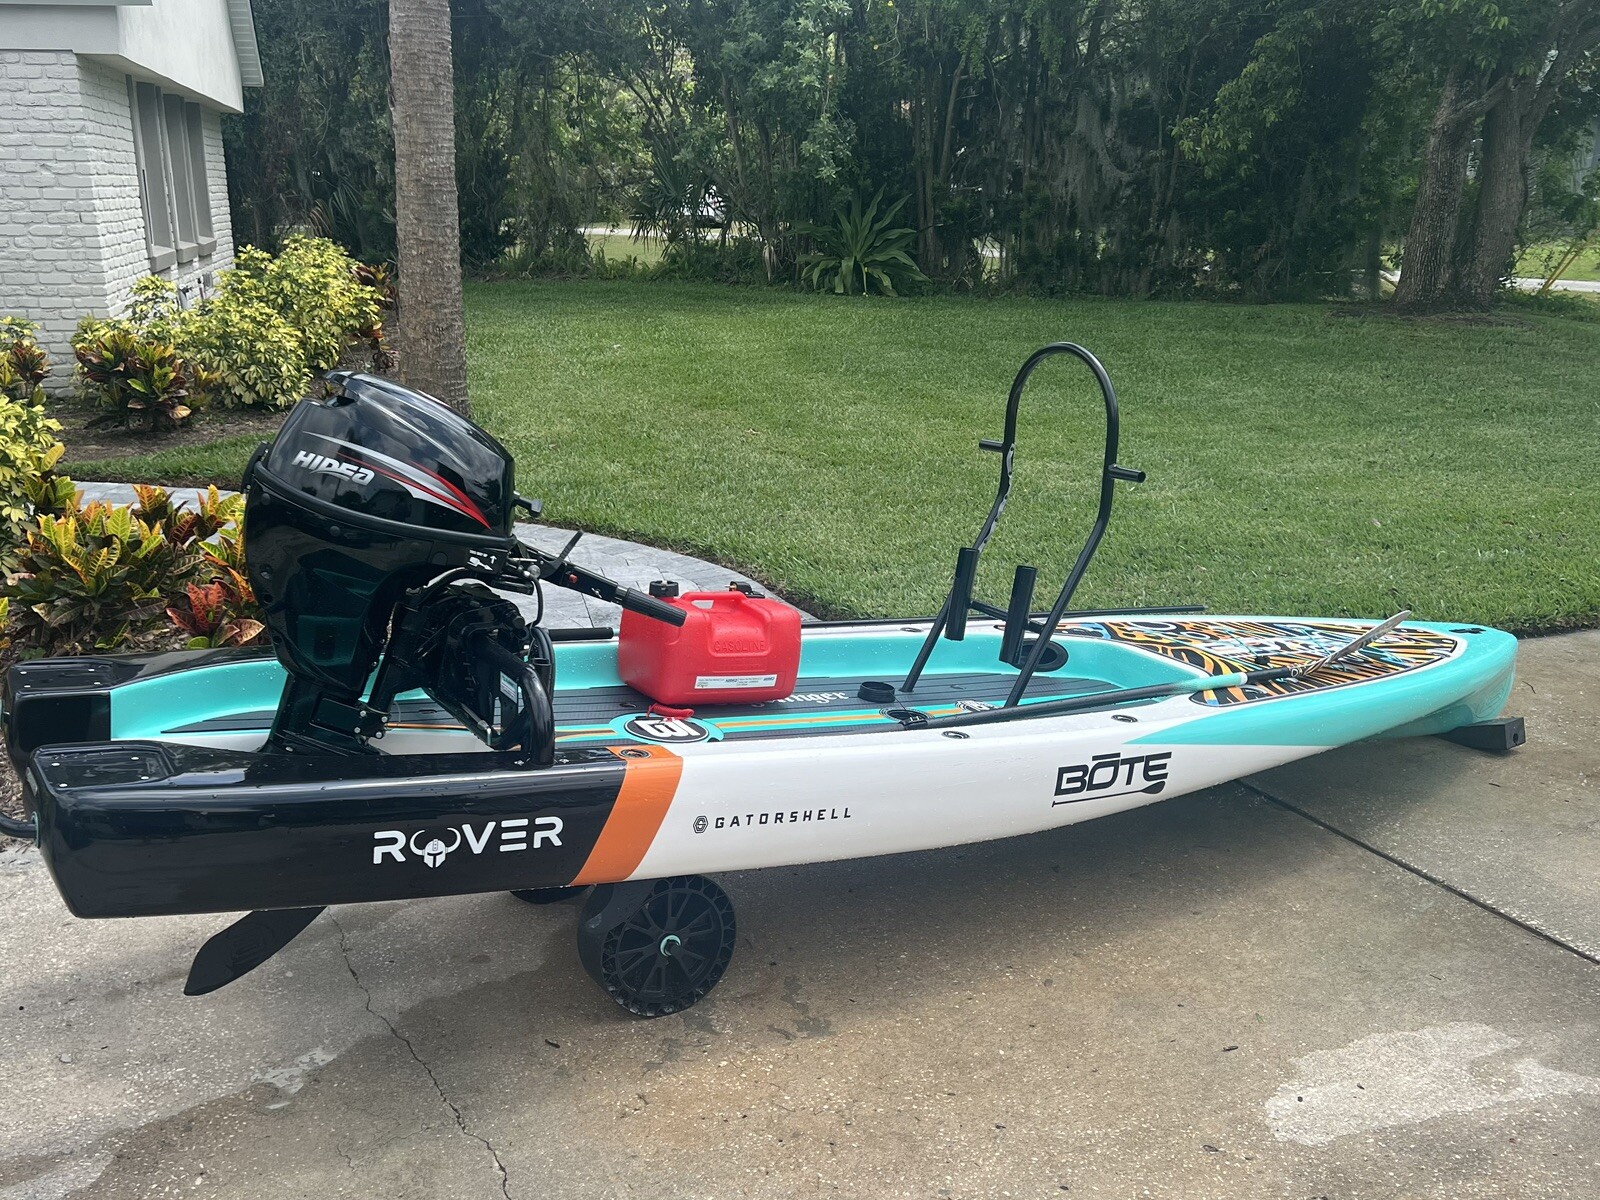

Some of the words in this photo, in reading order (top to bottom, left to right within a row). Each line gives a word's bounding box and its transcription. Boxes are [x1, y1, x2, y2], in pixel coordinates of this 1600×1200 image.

[292, 450, 375, 486] HIDEA
[713, 640, 766, 653] GASOLINE
[714, 807, 851, 829] GATORSHELL
